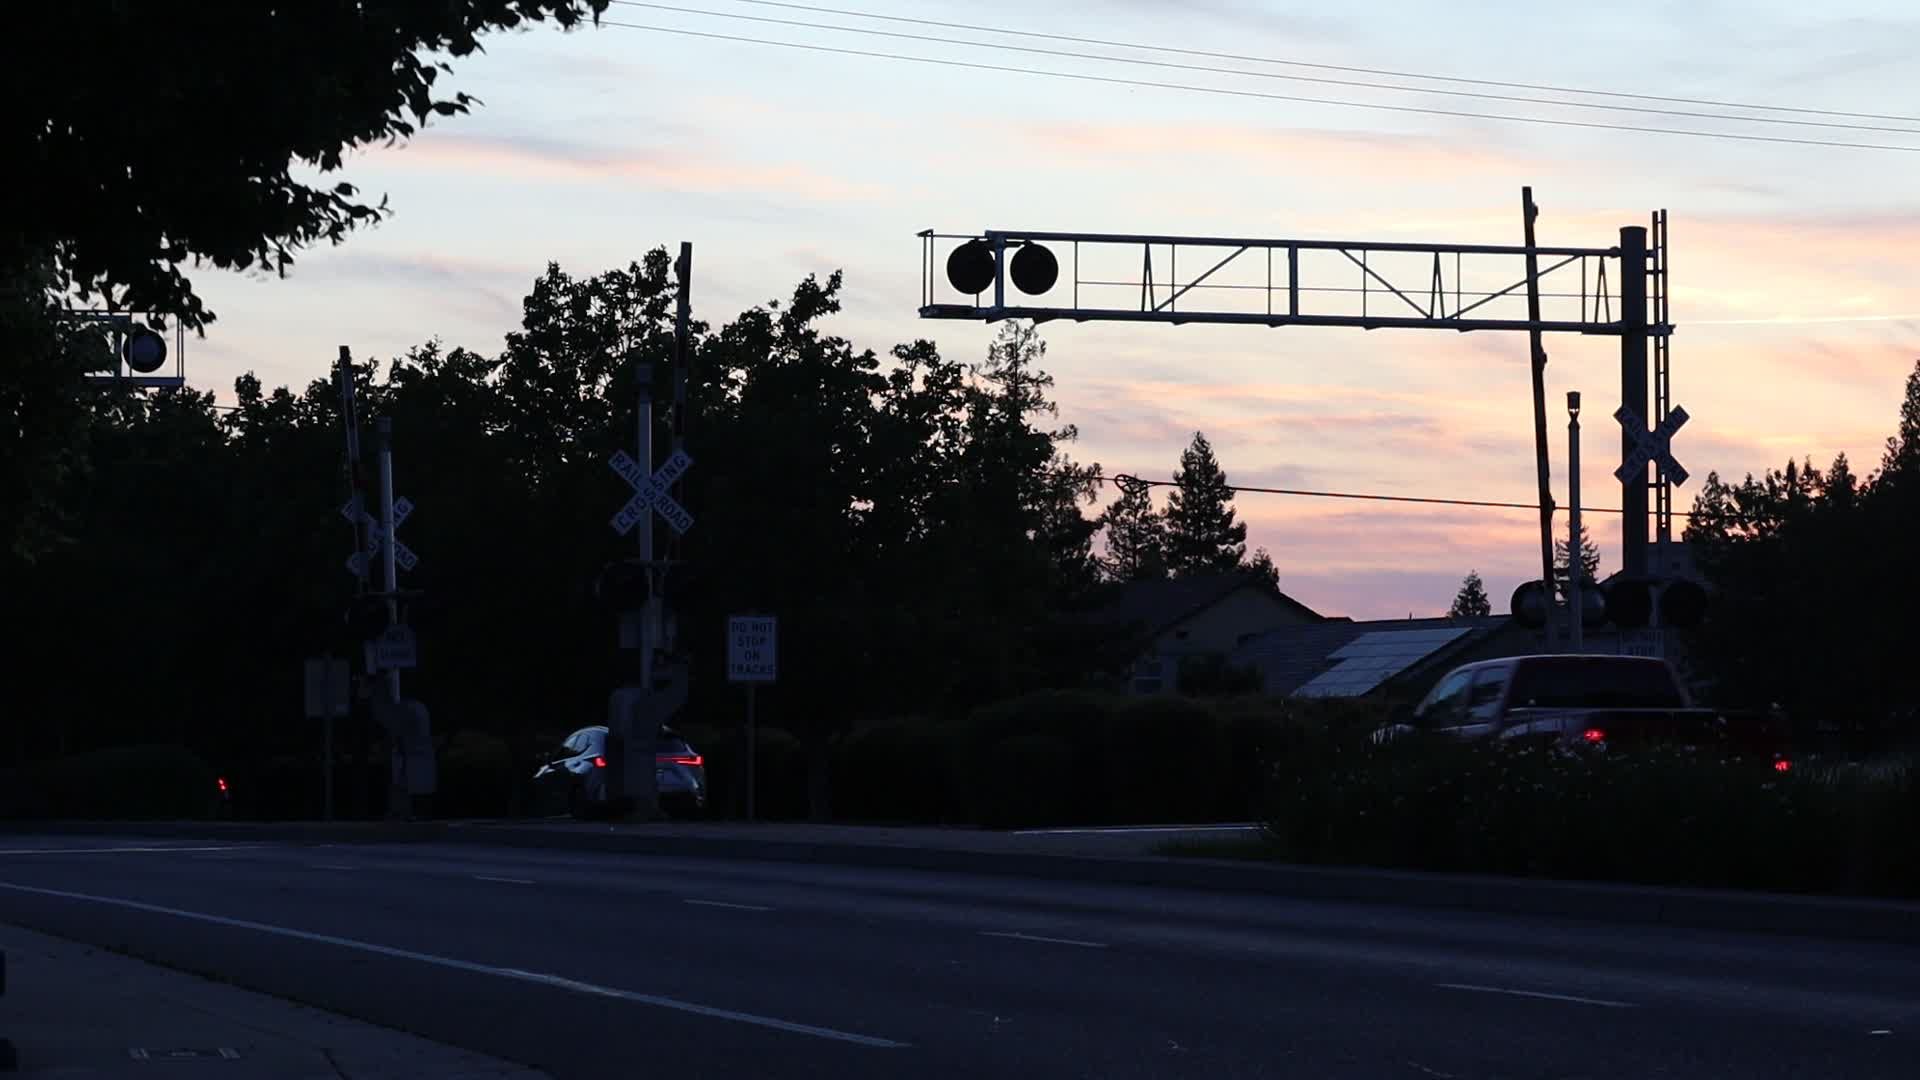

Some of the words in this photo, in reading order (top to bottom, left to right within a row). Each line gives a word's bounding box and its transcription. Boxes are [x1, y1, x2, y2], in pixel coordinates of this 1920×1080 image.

[617, 455, 686, 528] CROSSING
[732, 622, 747, 633] DO
[752, 621, 773, 633] NOT
[737, 635, 767, 648] STOP
[744, 649, 760, 661] ON
[731, 663, 773, 673] TRACKS
